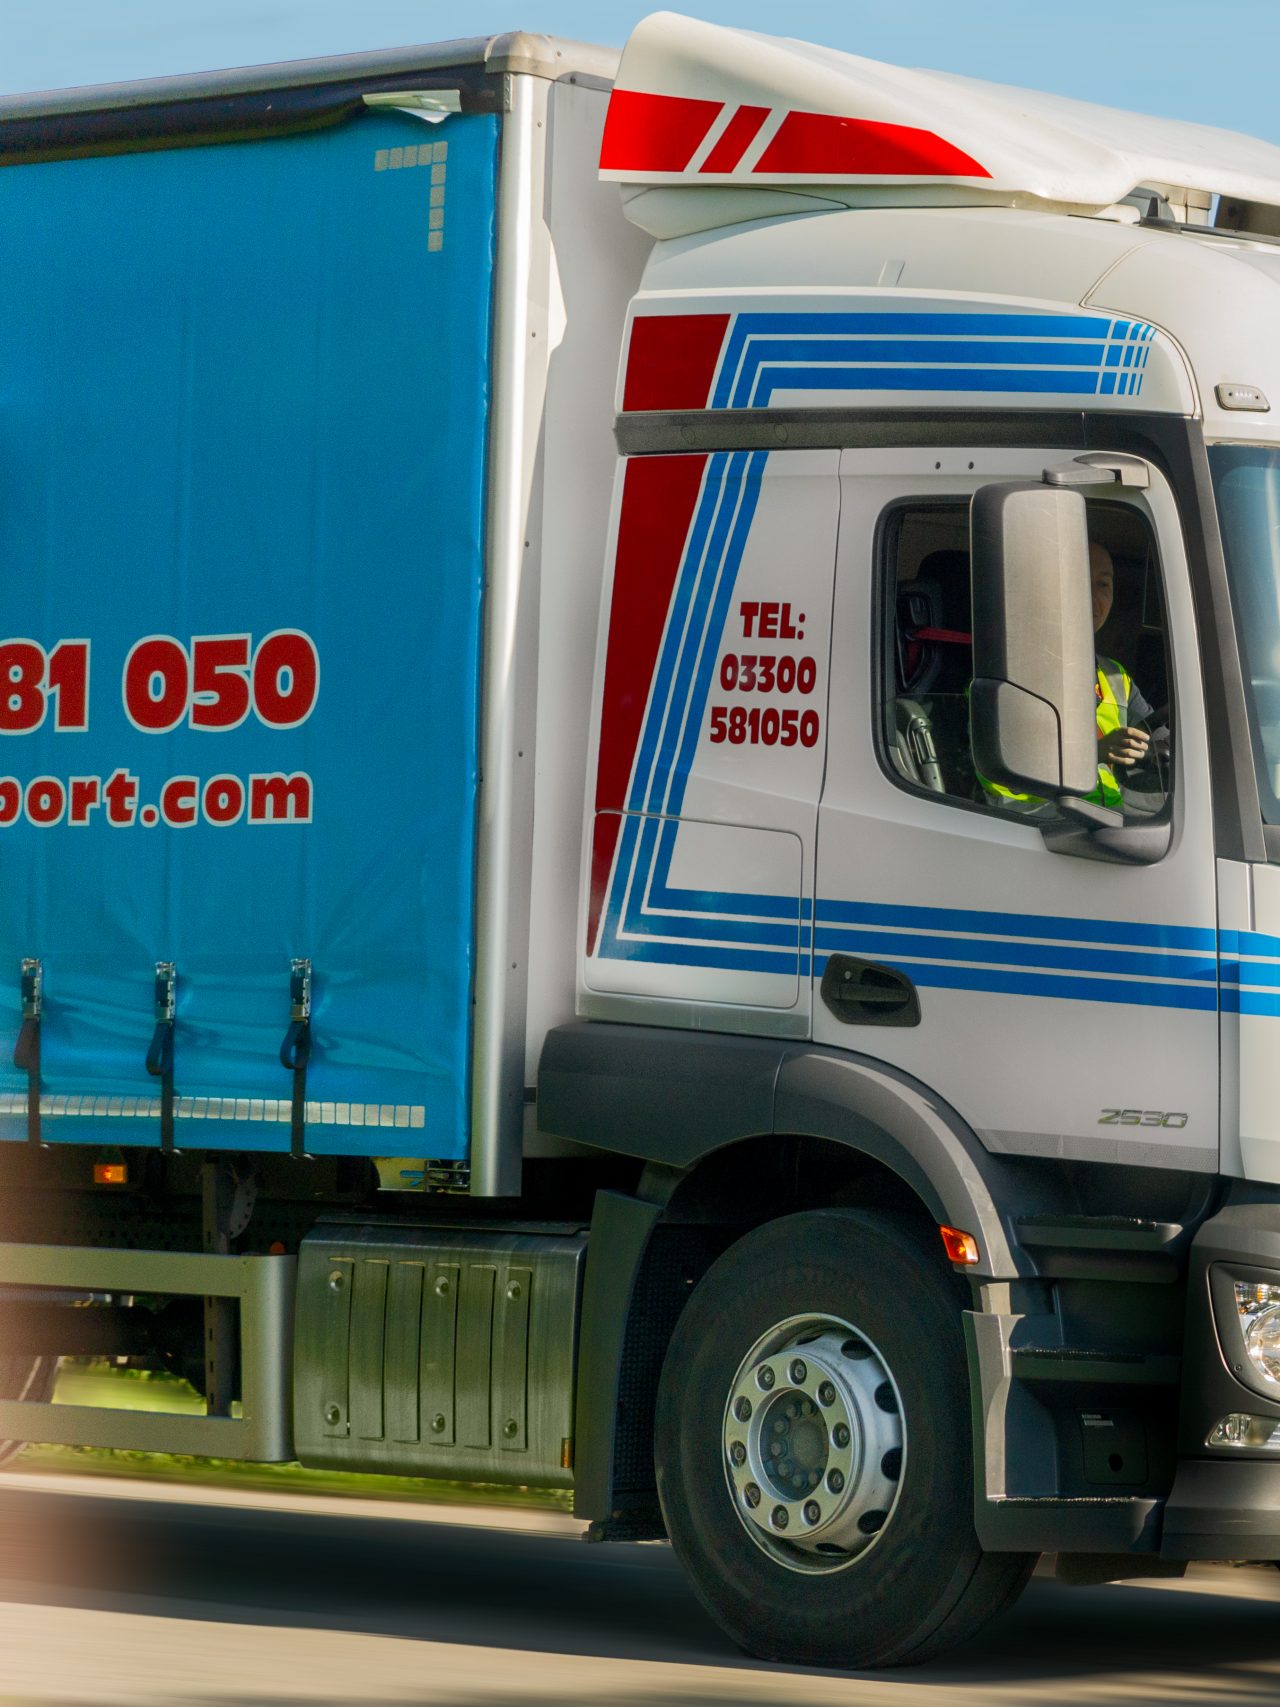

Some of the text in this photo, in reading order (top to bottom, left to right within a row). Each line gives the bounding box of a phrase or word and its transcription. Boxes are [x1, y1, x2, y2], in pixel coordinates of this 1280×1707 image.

[740, 601, 806, 640] TEL:
[0, 627, 320, 736] 81 050
[720, 653, 817, 695] 03300
[710, 706, 820, 748] 581050
[1097, 1109, 1188, 1128] 2530
